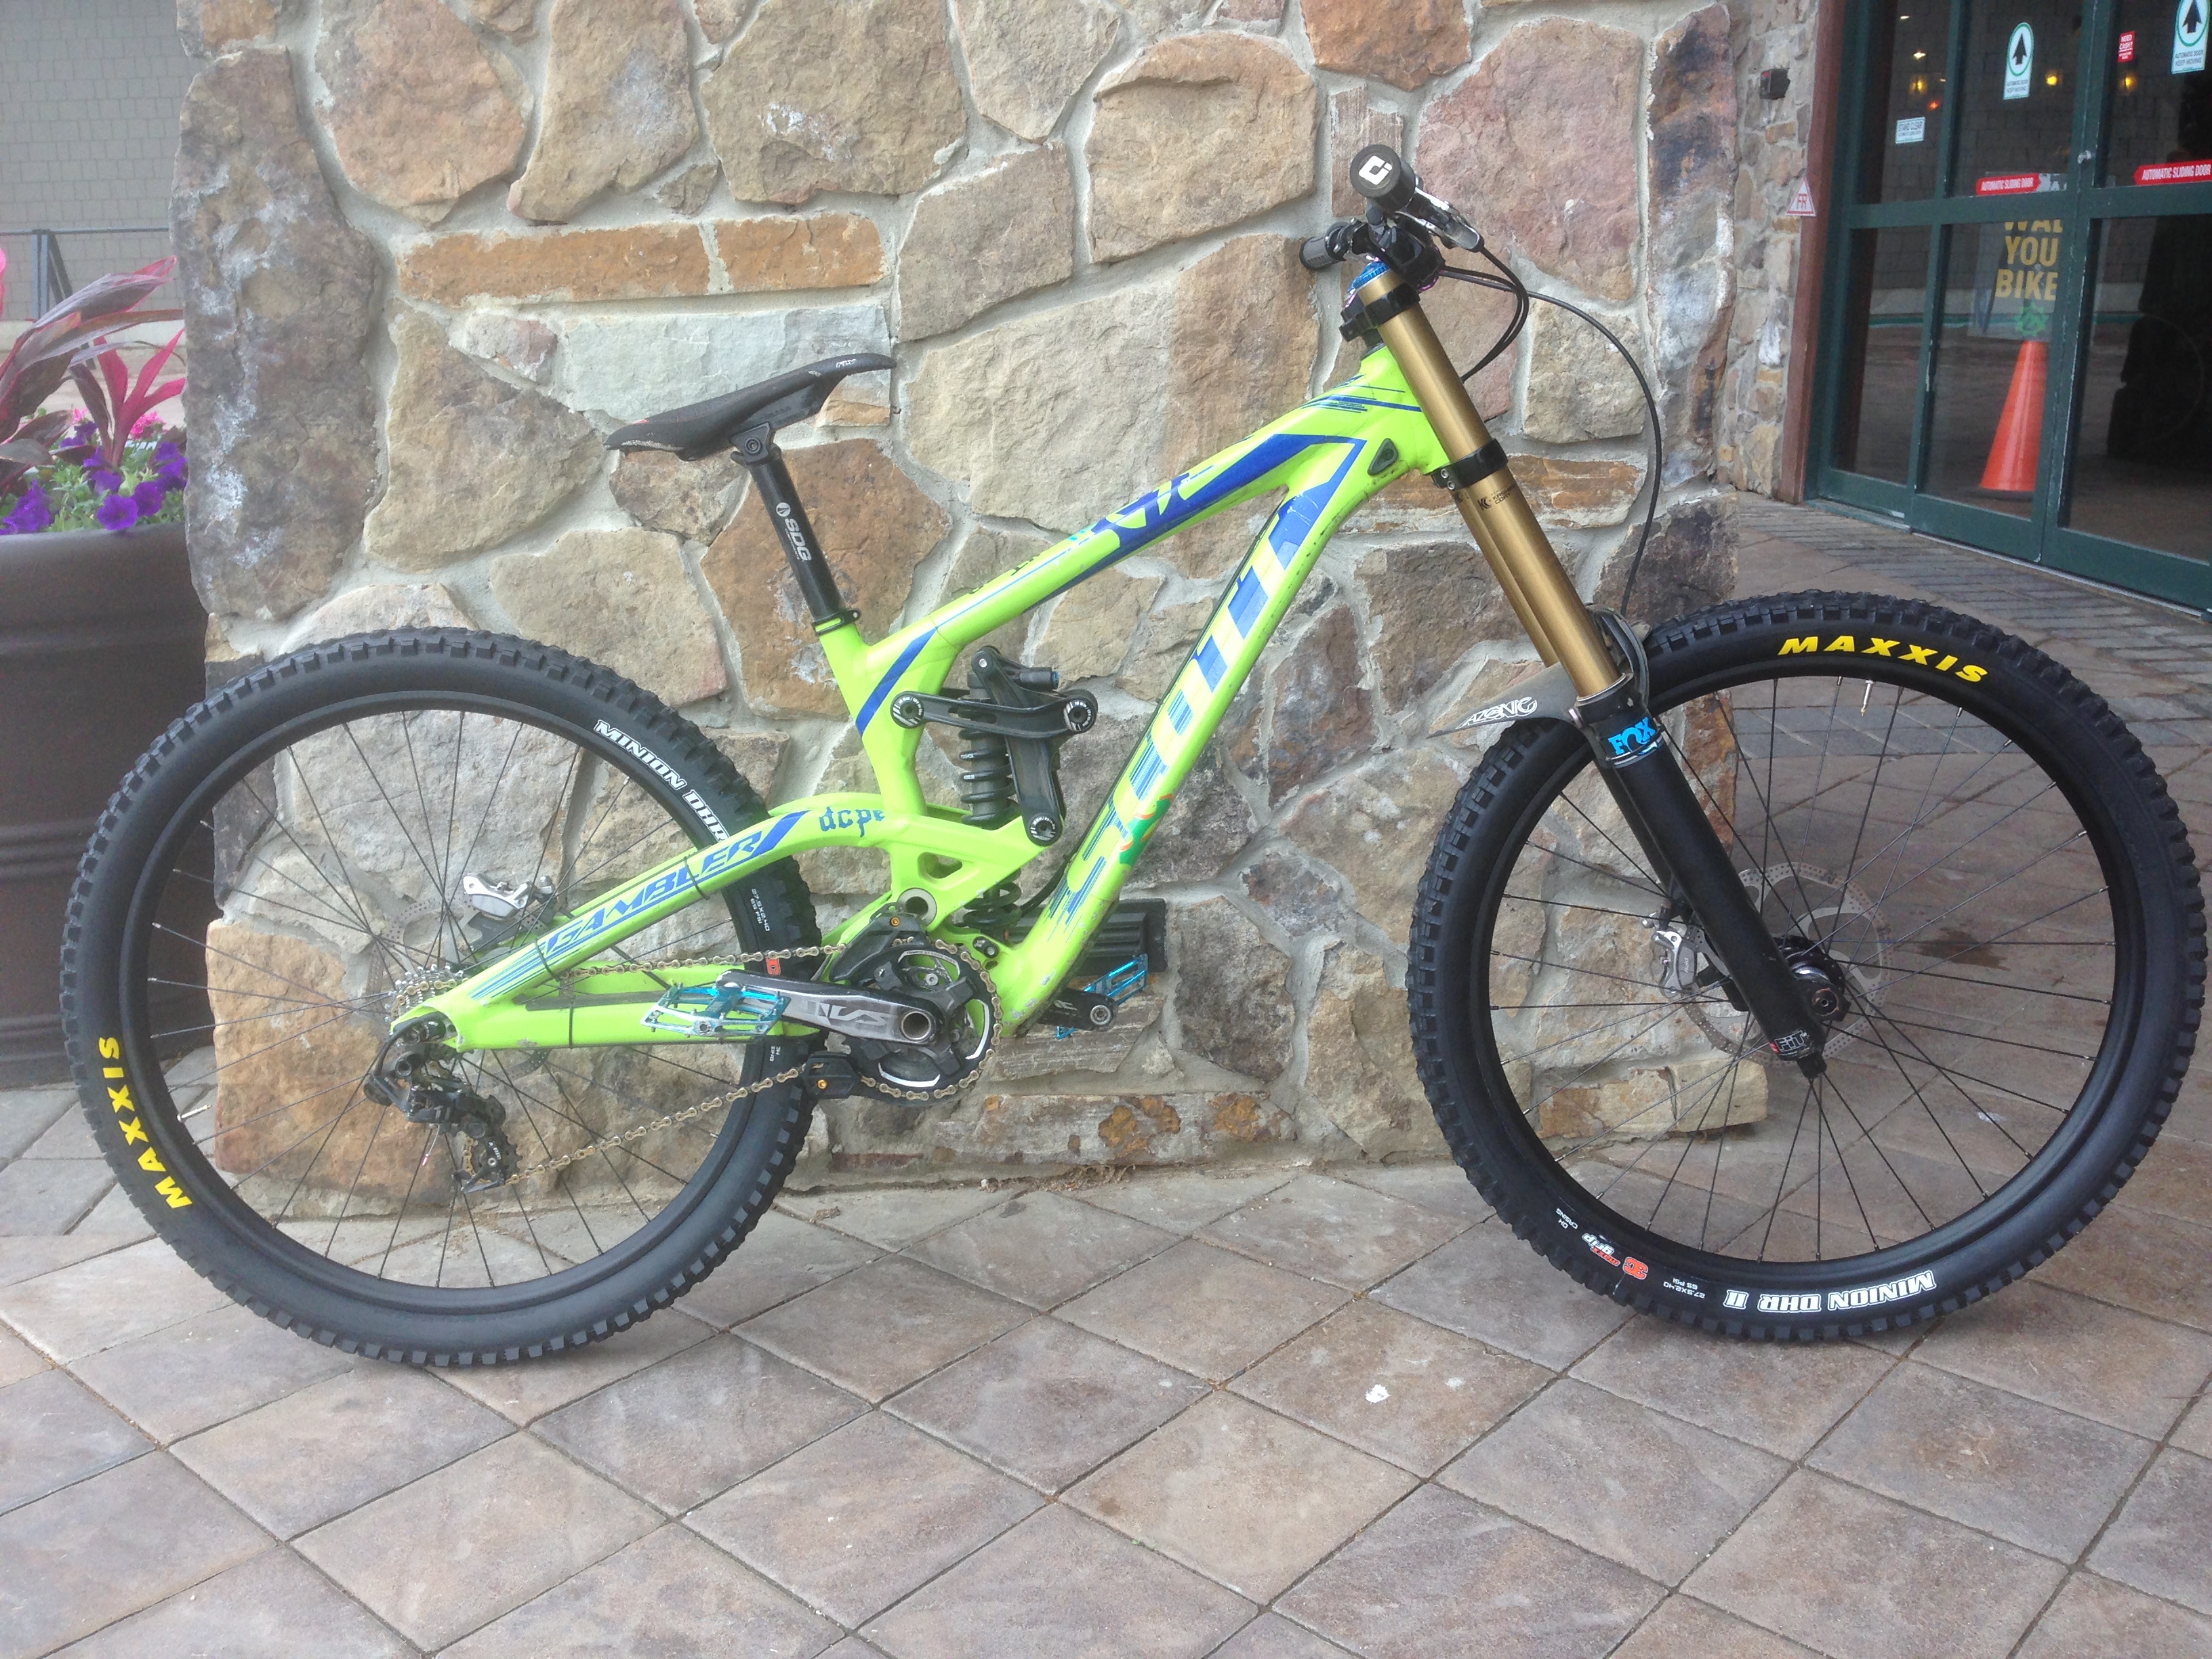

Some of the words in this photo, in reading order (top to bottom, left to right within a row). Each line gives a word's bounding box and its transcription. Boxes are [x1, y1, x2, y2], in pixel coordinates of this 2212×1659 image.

[1981, 180, 2004, 192] AUTOMATIC
[2004, 178, 2021, 189] SLIDING
[2021, 177, 2034, 188] DOOR
[2142, 167, 2172, 180] AUTOMATIC
[2173, 165, 2194, 178] SLIDING
[2195, 164, 2211, 176] DOOR
[2005, 236, 2059, 267] YOU
[1995, 268, 2058, 301] BIKE
[785, 518, 812, 560] SDG
[1778, 635, 1989, 682] MAXXIS
[1455, 697, 1538, 730] AZONIC
[1608, 717, 1656, 755] FOX
[594, 720, 687, 790] MINION
[682, 790, 730, 842] DHR
[543, 831, 763, 956] GAMBLER
[99, 1037, 192, 1209] MAXXIS
[1723, 1289, 1749, 1310] II
[1757, 1294, 1822, 1313] DHR
[1828, 1271, 1938, 1311] MINION
